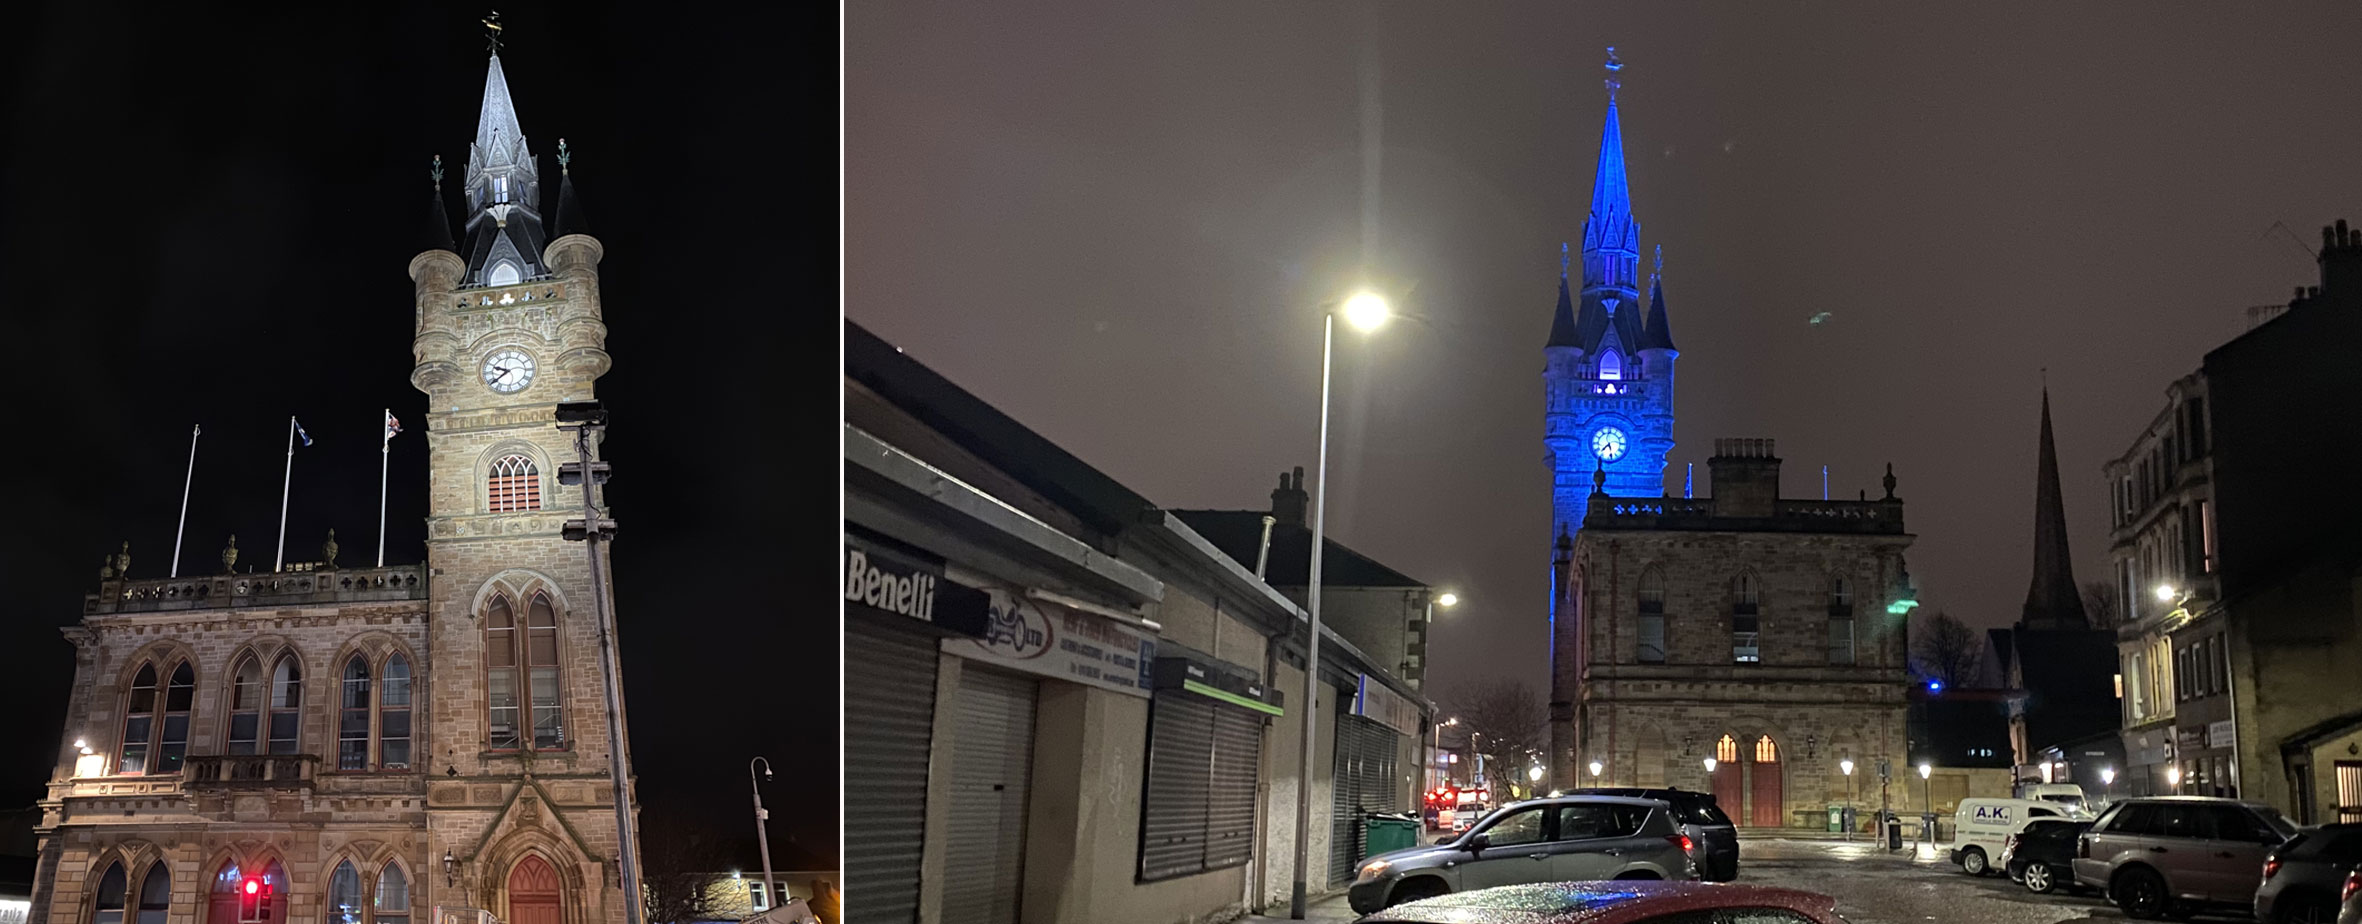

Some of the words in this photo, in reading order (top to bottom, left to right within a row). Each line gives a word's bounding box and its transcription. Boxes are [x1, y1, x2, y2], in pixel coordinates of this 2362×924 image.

[845, 550, 935, 621] Benelli
[1026, 628, 1042, 647] LTD
[1976, 806, 2008, 819] A.K.
